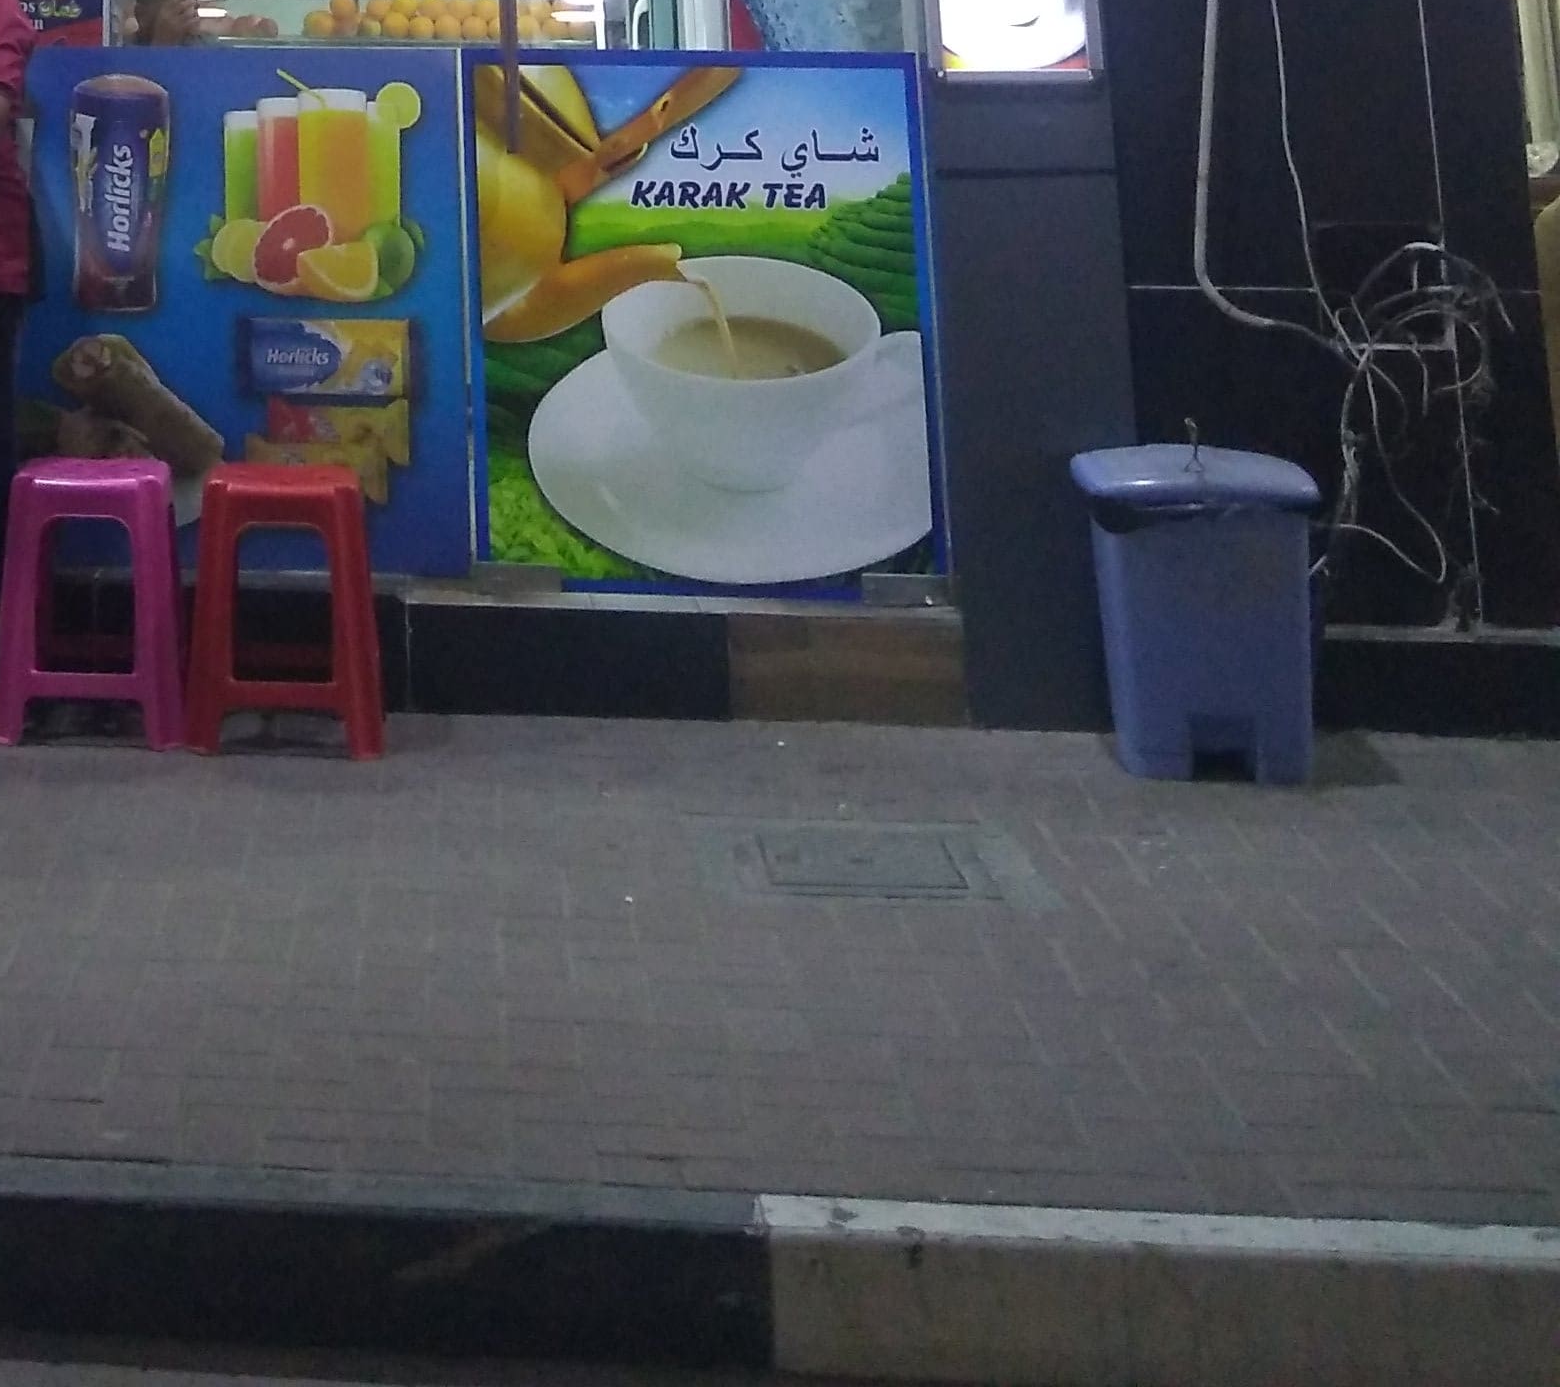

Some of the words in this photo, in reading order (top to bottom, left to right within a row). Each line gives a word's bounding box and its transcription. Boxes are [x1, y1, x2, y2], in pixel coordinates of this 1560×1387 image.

[669, 123, 760, 171] كرك
[781, 127, 880, 178] شاي
[104, 144, 134, 252] Horlicks
[630, 180, 750, 211] KARAK
[761, 182, 828, 210] TEA
[266, 348, 330, 366] Horlicks
